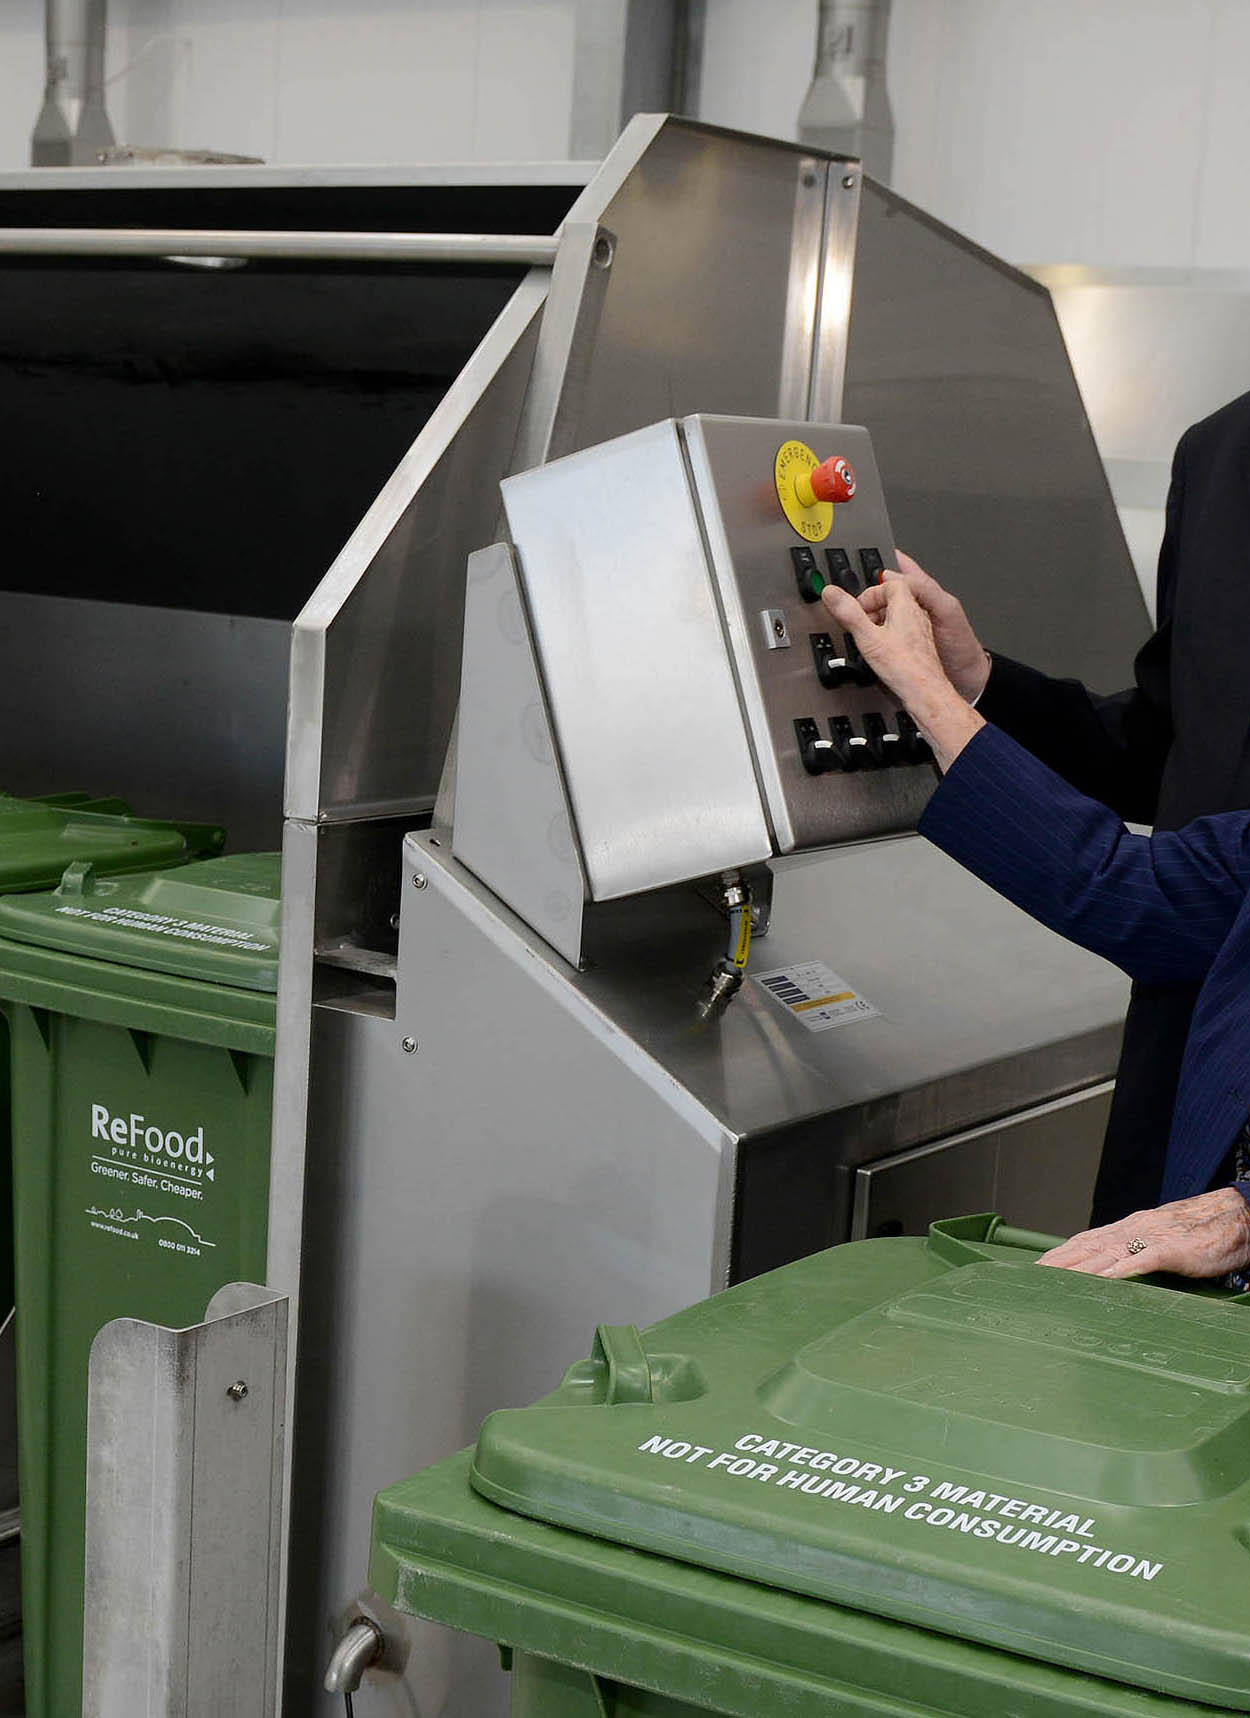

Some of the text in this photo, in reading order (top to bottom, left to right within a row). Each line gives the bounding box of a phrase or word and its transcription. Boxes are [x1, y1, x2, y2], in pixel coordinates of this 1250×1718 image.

[801, 520, 823, 537] STOP
[83, 912, 118, 922] FOR
[112, 918, 170, 932] HUMAN
[163, 928, 272, 951] CONSUMPTION
[103, 907, 178, 924] CATEGORY
[183, 922, 254, 940] MATERIAL
[92, 1104, 204, 1163] ReFood
[91, 1161, 203, 1200] Greener. Safer. Cheaper.
[112, 1147, 203, 1177] pure bioenergy
[734, 1434, 1096, 1538] CATEGORY 3 MATERIAL
[638, 1435, 1164, 1581] NOT FOR HUMAN CONSUMPTION
